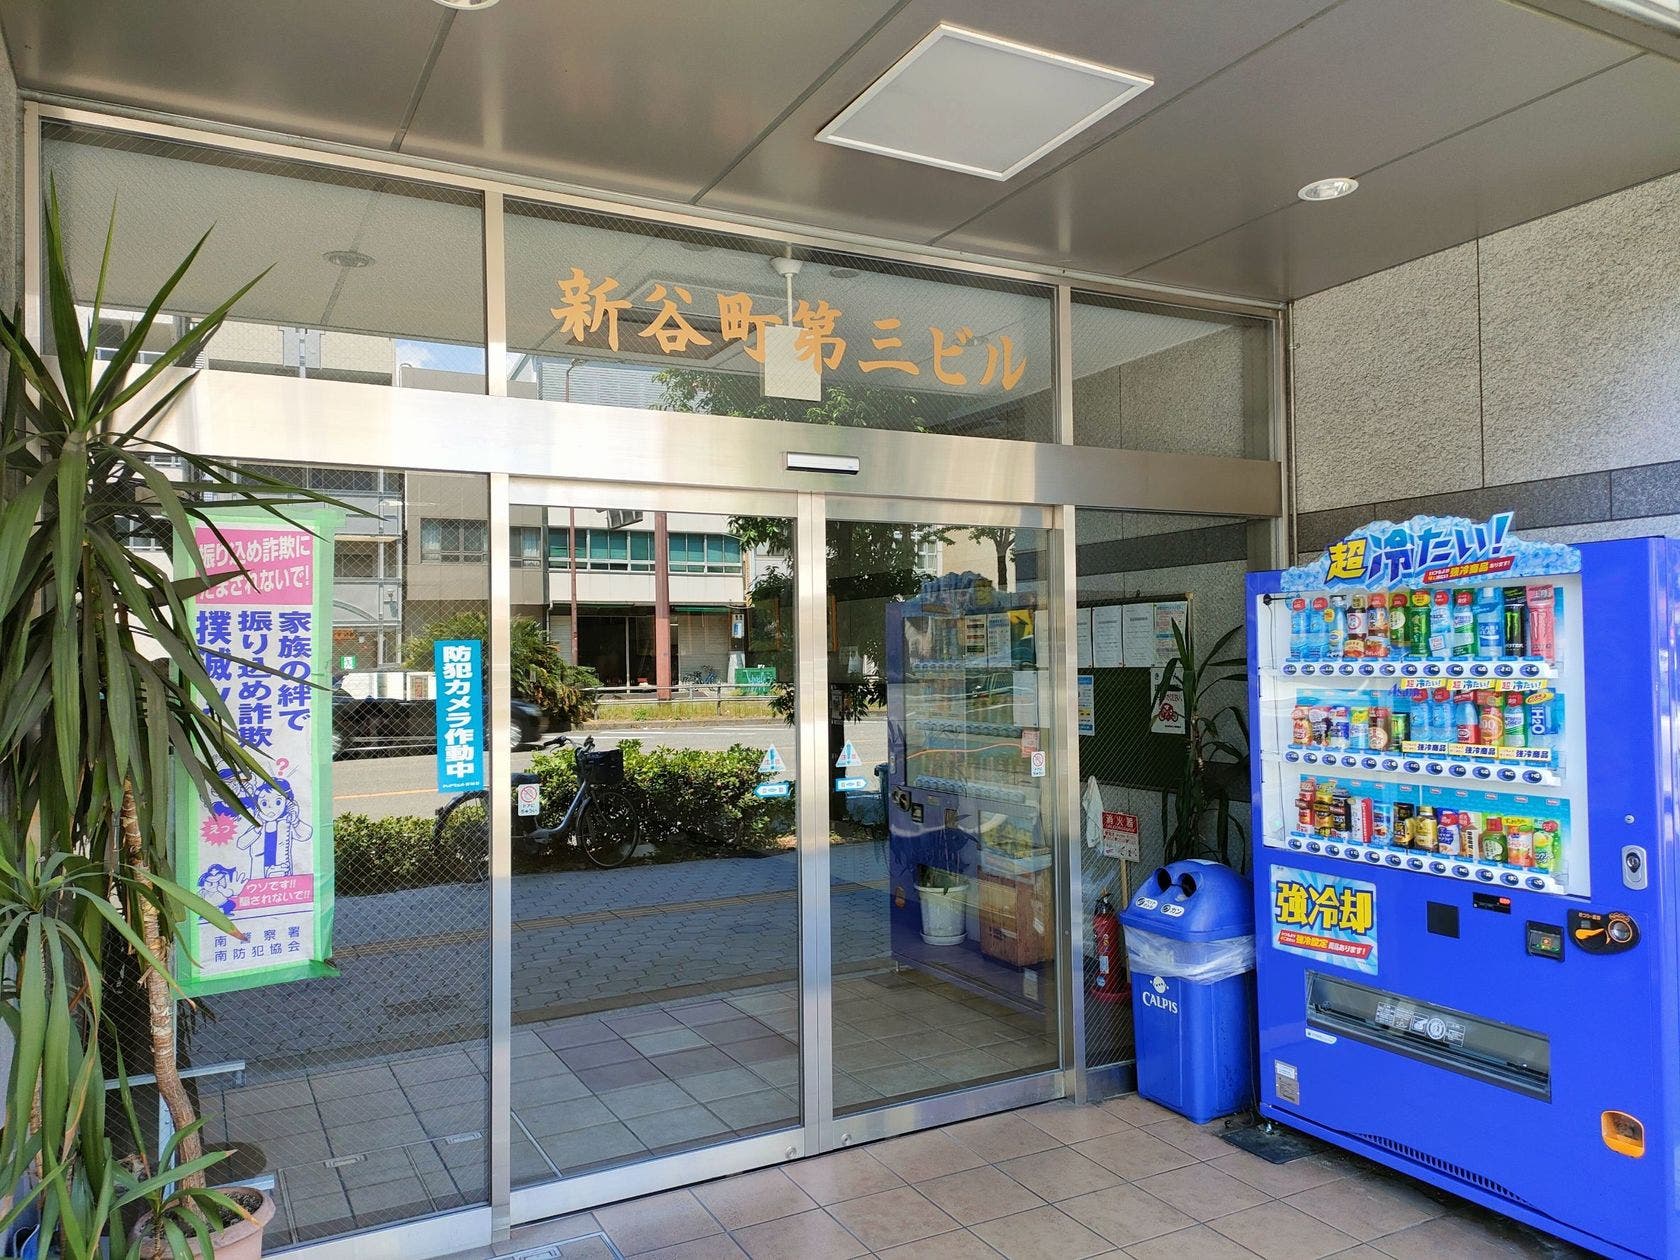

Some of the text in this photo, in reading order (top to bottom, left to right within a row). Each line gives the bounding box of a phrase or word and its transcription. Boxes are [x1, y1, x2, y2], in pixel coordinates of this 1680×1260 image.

[550, 267, 1028, 391] 新谷町第三ビル
[277, 611, 311, 731] 家族の絆で
[442, 645, 475, 778] 防犯カメラ作動中
[1276, 881, 1373, 935] 強冷却
[214, 941, 301, 963] 南防犯協会
[1142, 991, 1179, 1015] CALPIS
